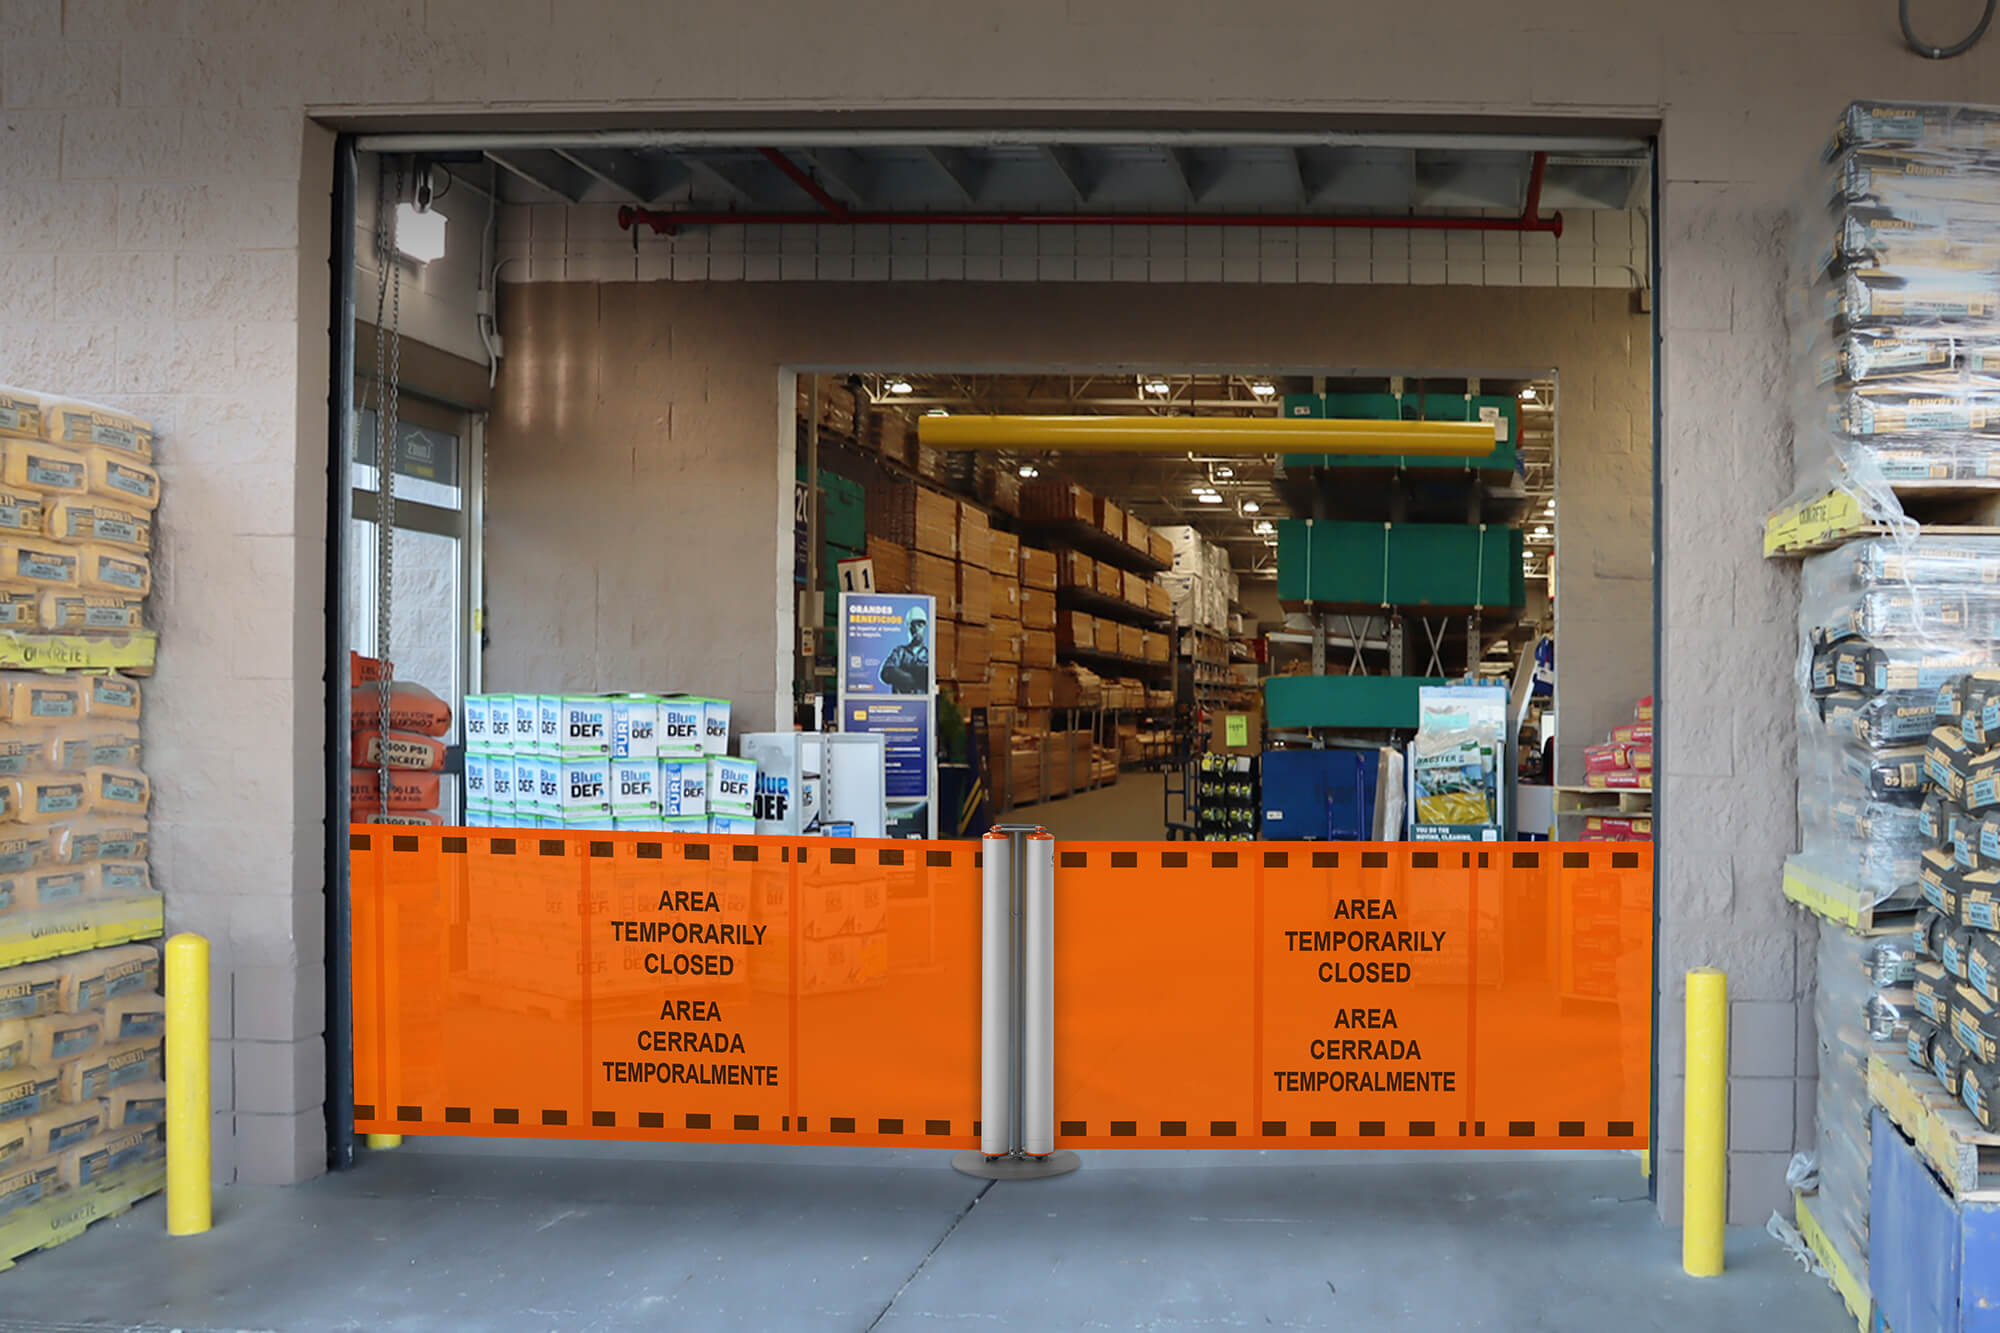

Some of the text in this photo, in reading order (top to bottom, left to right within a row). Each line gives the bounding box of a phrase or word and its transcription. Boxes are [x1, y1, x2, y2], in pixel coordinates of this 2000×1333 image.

[844, 568, 870, 592] 11
[570, 711, 603, 723] Blue
[667, 711, 697, 723] Blue
[570, 724, 603, 738] DEF
[616, 711, 628, 757] PURE
[667, 724, 697, 737] DEF
[374, 753, 426, 767] CNCRETE
[409, 745, 428, 755] PSI
[571, 771, 603, 784] Blue
[621, 770, 651, 781] Blue
[721, 768, 749, 780] Blue
[571, 783, 603, 798] DEF
[621, 782, 651, 795] DEF
[720, 780, 749, 795] DEF
[658, 890, 720, 912] AREA
[1334, 899, 1397, 919] AREA
[611, 921, 767, 945] TEMPORARILY
[1285, 931, 1446, 951] TEMPORARILY
[644, 953, 734, 975] CLOSED
[1318, 962, 1411, 983] CLOSED
[660, 1000, 722, 1022] AREA
[1334, 1008, 1398, 1028] AREA
[637, 1030, 745, 1053] CERRADA
[1310, 1039, 1421, 1060] CERRADA
[602, 1061, 778, 1086] TEMPORALMENTE
[1274, 1071, 1455, 1092] TEMPORALMENTE
